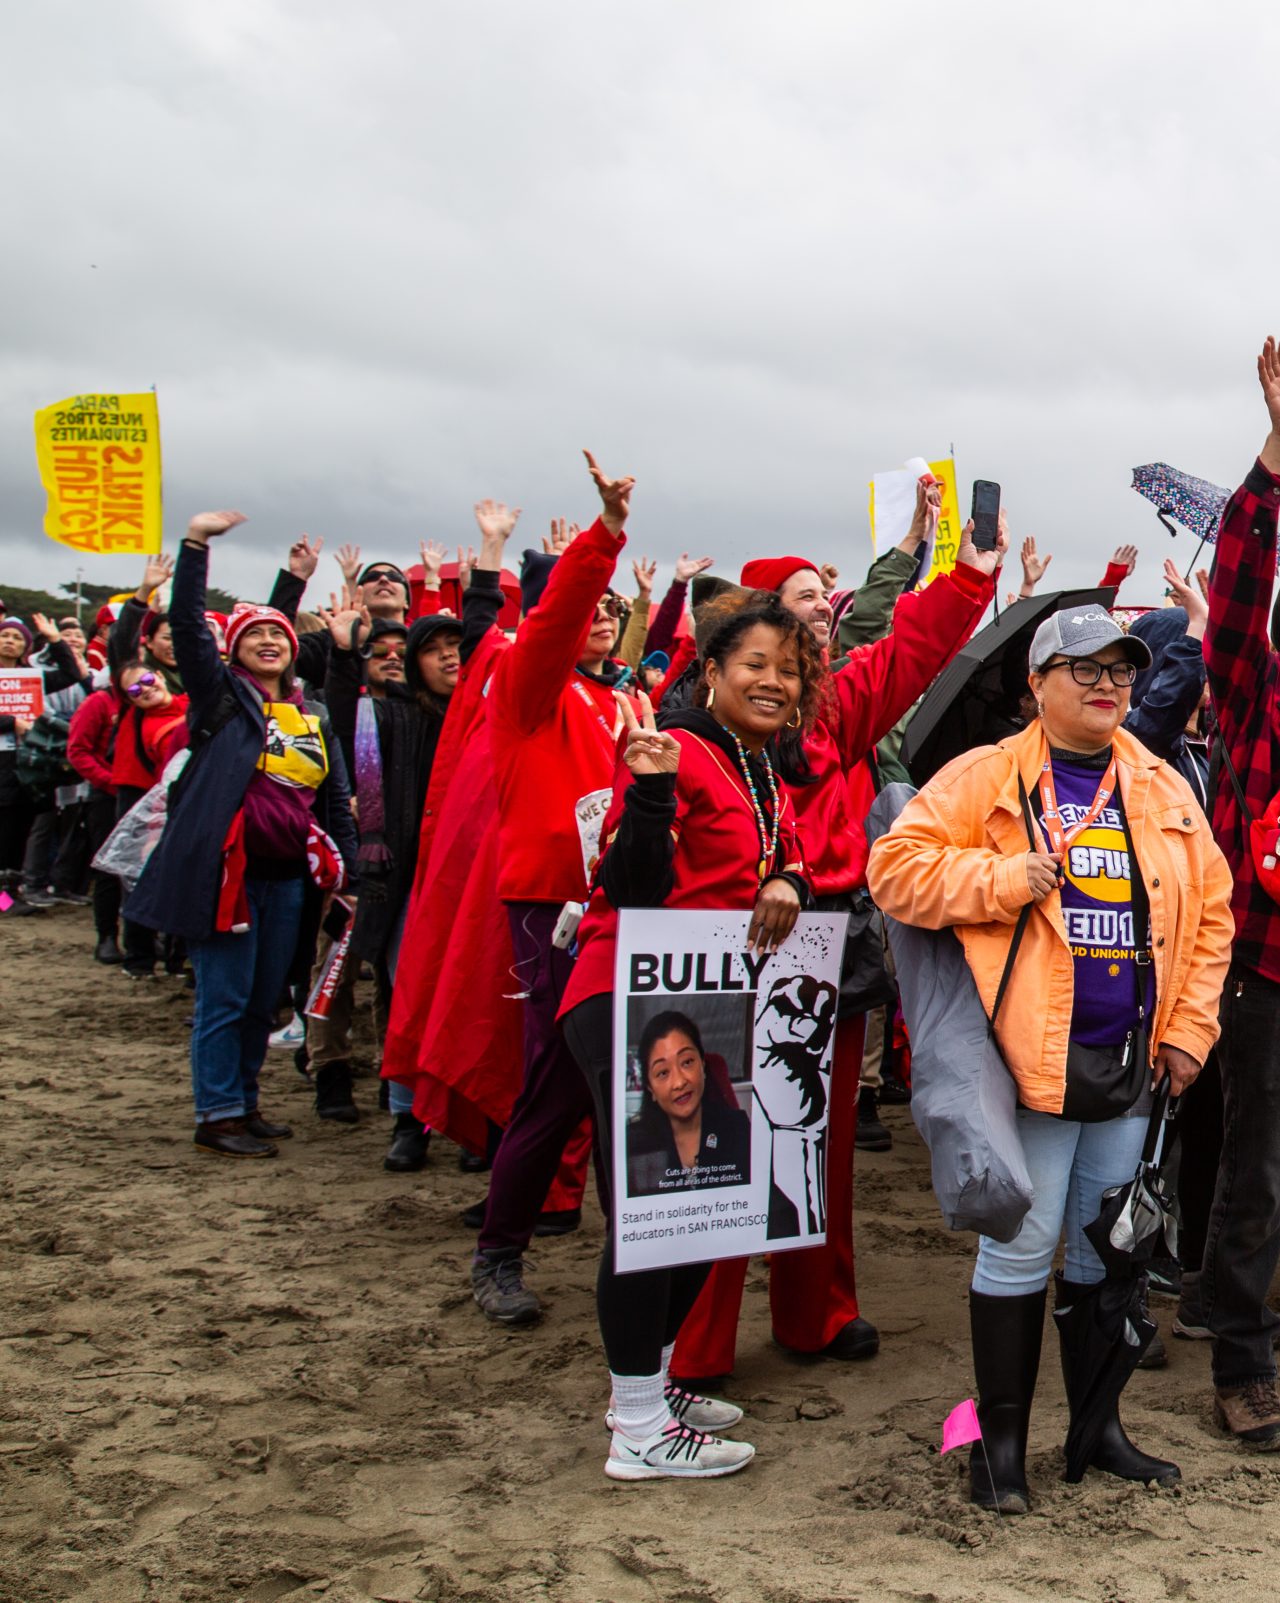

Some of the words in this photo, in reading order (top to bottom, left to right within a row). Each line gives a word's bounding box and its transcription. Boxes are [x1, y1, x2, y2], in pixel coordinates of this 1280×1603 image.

[0, 693, 33, 703] TRIKE
[578, 803, 600, 823] WE
[1062, 908, 1118, 946] EIU
[1090, 947, 1129, 959] UNION
[322, 959, 344, 998] FULLY
[629, 952, 772, 993] BULLY
[659, 1180, 675, 1188] from
[675, 1179, 684, 1187] all
[684, 1177, 701, 1186] areas
[702, 1176, 709, 1184] of
[709, 1175, 719, 1183] the
[720, 1173, 743, 1182] district.
[665, 1168, 681, 1177] Cuts
[692, 1165, 711, 1176] going
[711, 1165, 719, 1173] to
[719, 1164, 736, 1172] come
[622, 1210, 653, 1224] Stand
[655, 1209, 665, 1220] in
[667, 1203, 713, 1218] solidarity
[715, 1201, 729, 1213] for
[731, 1199, 749, 1210] the
[622, 1226, 674, 1242] educators
[676, 1225, 686, 1235] in
[688, 1221, 709, 1234] SAN
[711, 1213, 768, 1231] FRANCISCO
